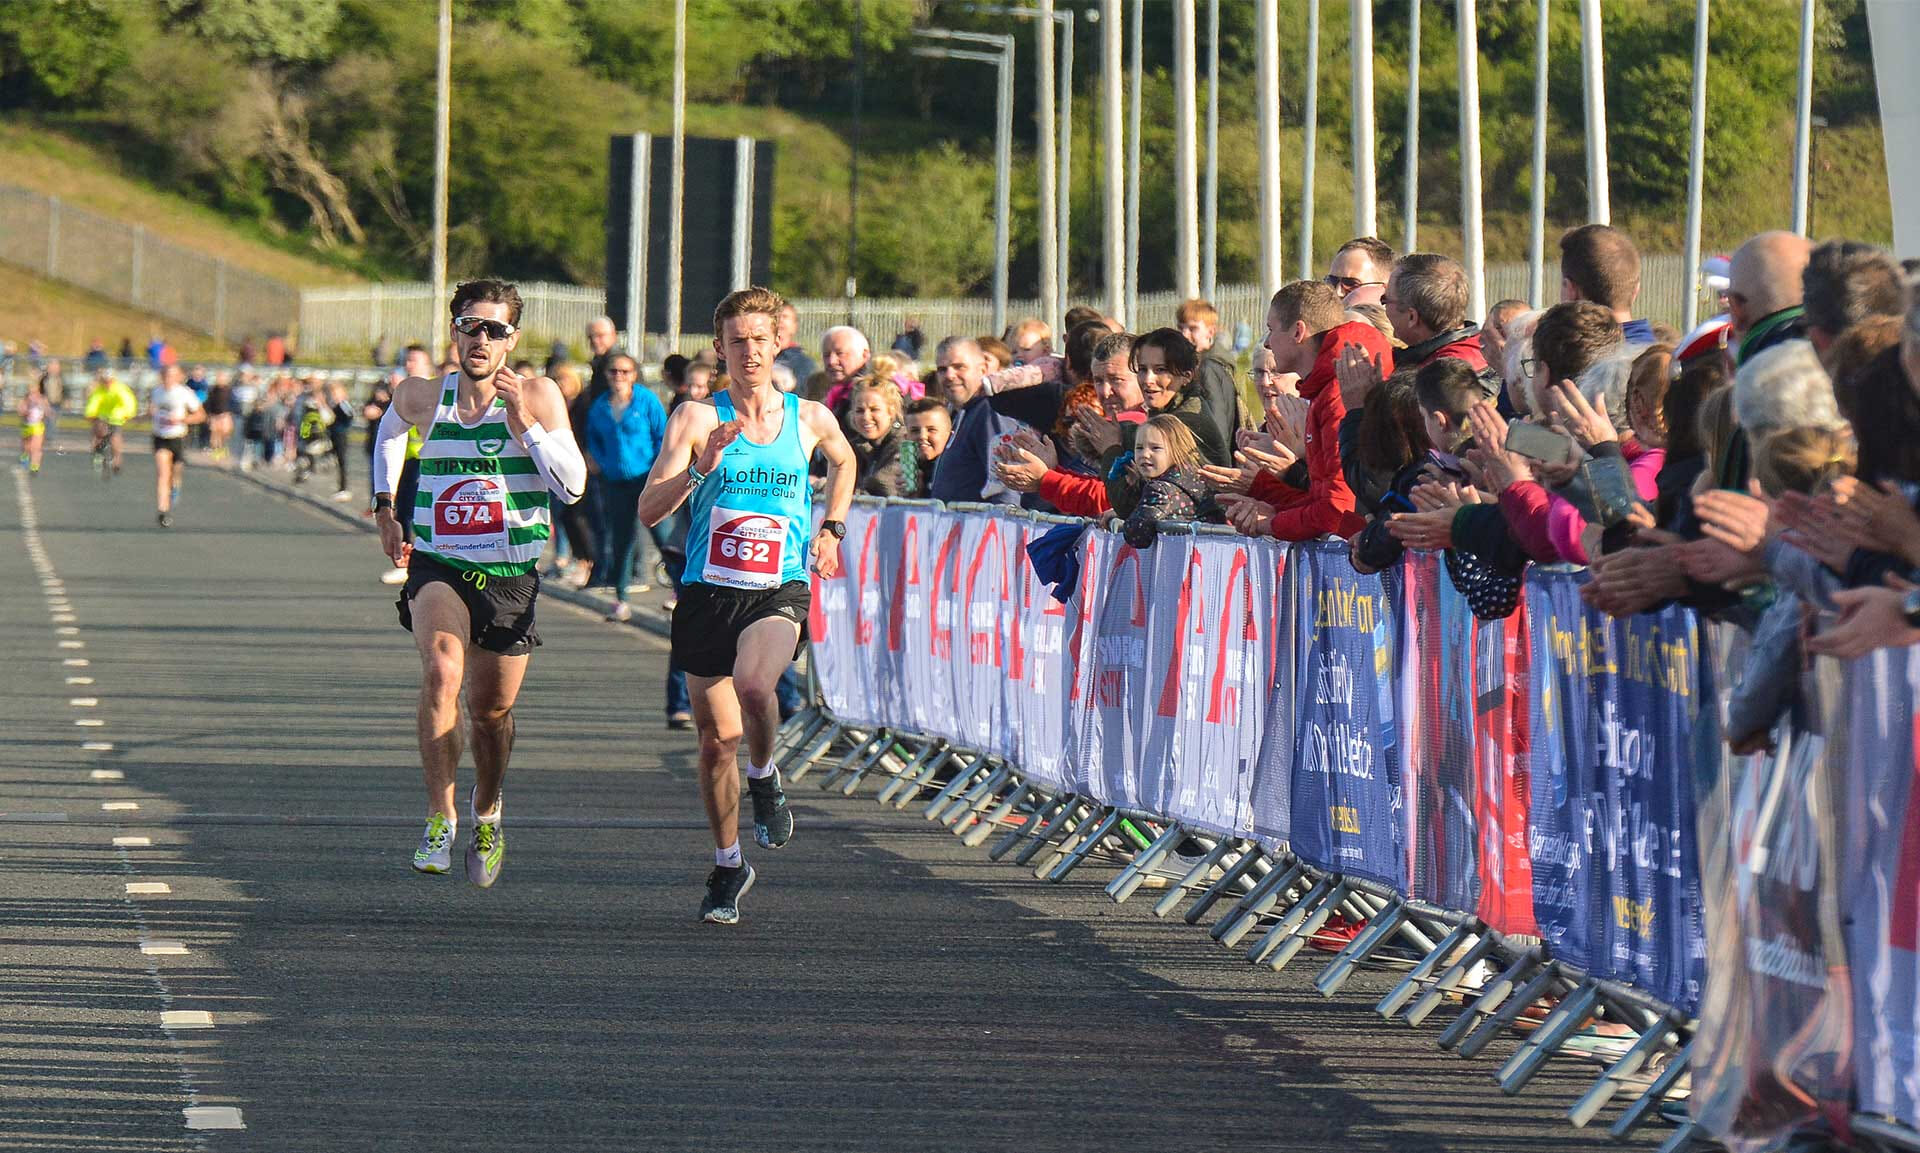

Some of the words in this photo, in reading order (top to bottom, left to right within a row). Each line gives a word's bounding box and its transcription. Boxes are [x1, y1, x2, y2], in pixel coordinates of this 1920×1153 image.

[434, 460, 497, 473] TIPTON
[723, 467, 798, 487] Lothian
[720, 485, 768, 498] Running
[771, 487, 796, 499] Club
[444, 505, 493, 525] 674
[740, 526, 783, 535] SUNDERLAND
[720, 537, 770, 563] 662
